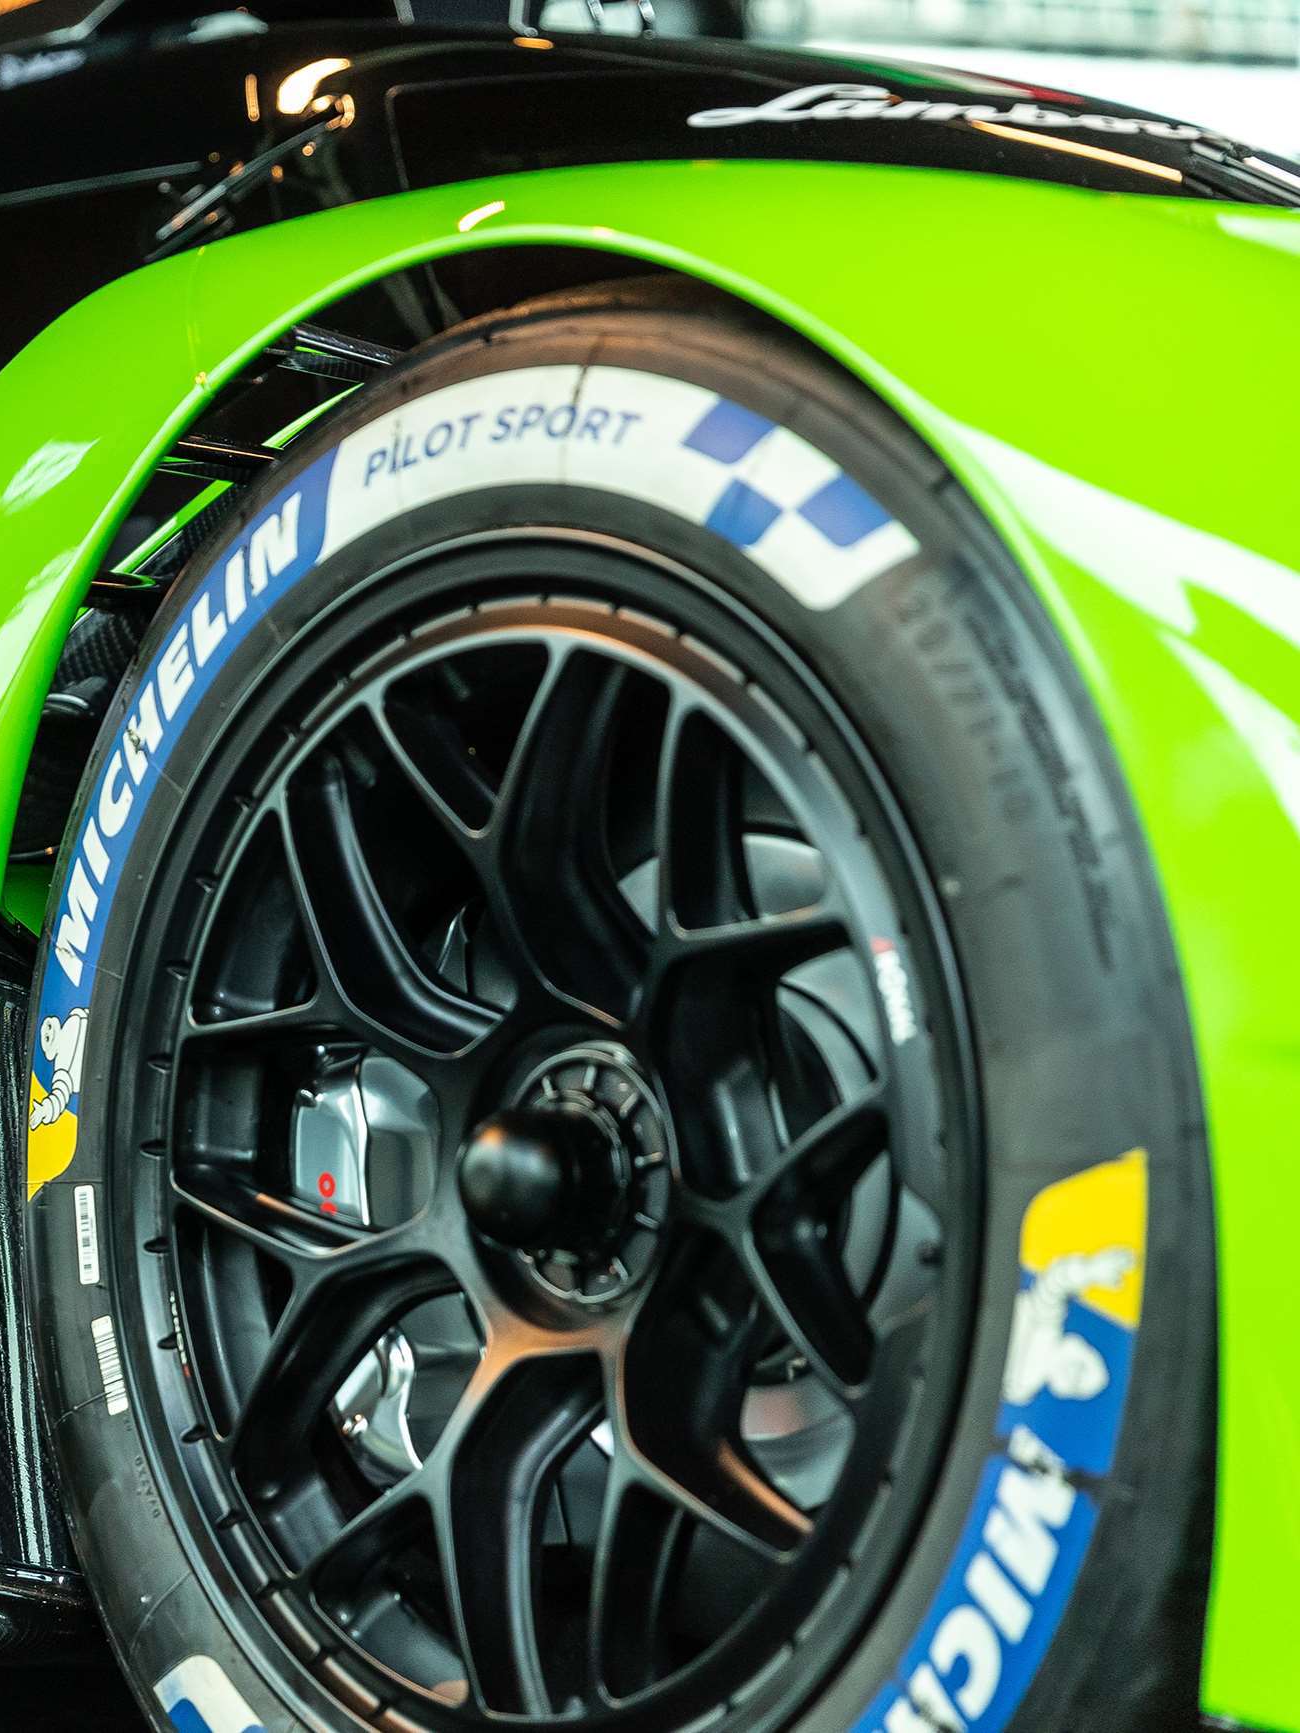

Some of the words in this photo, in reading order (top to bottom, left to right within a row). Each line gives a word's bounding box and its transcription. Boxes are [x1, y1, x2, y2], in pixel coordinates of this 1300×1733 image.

[364, 412, 484, 488] PILOT
[490, 403, 643, 446] SPORT
[54, 491, 302, 988] MICHELIN
